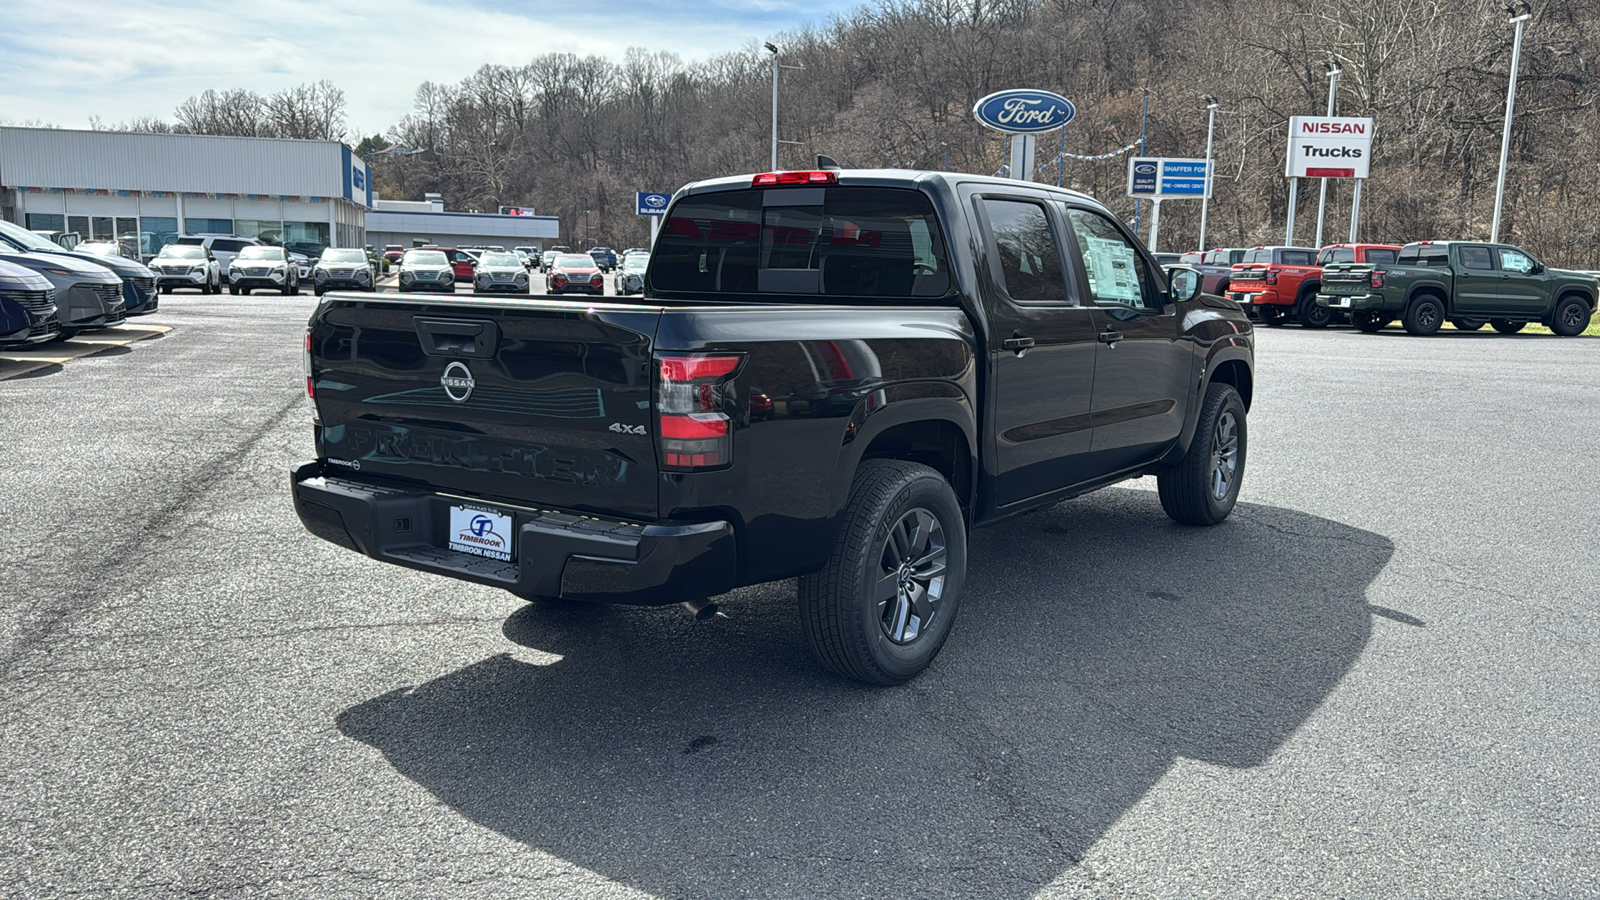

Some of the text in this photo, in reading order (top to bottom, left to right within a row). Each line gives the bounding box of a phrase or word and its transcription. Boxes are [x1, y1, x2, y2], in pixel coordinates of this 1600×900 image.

[998, 98, 1056, 123] Ford
[1302, 122, 1365, 134] NISSAN
[1302, 145, 1362, 158] Trucks
[441, 378, 475, 388] NISSAN
[459, 534, 501, 547] TIMBROOK
[448, 542, 511, 561] TIMBROOK NISSAN
